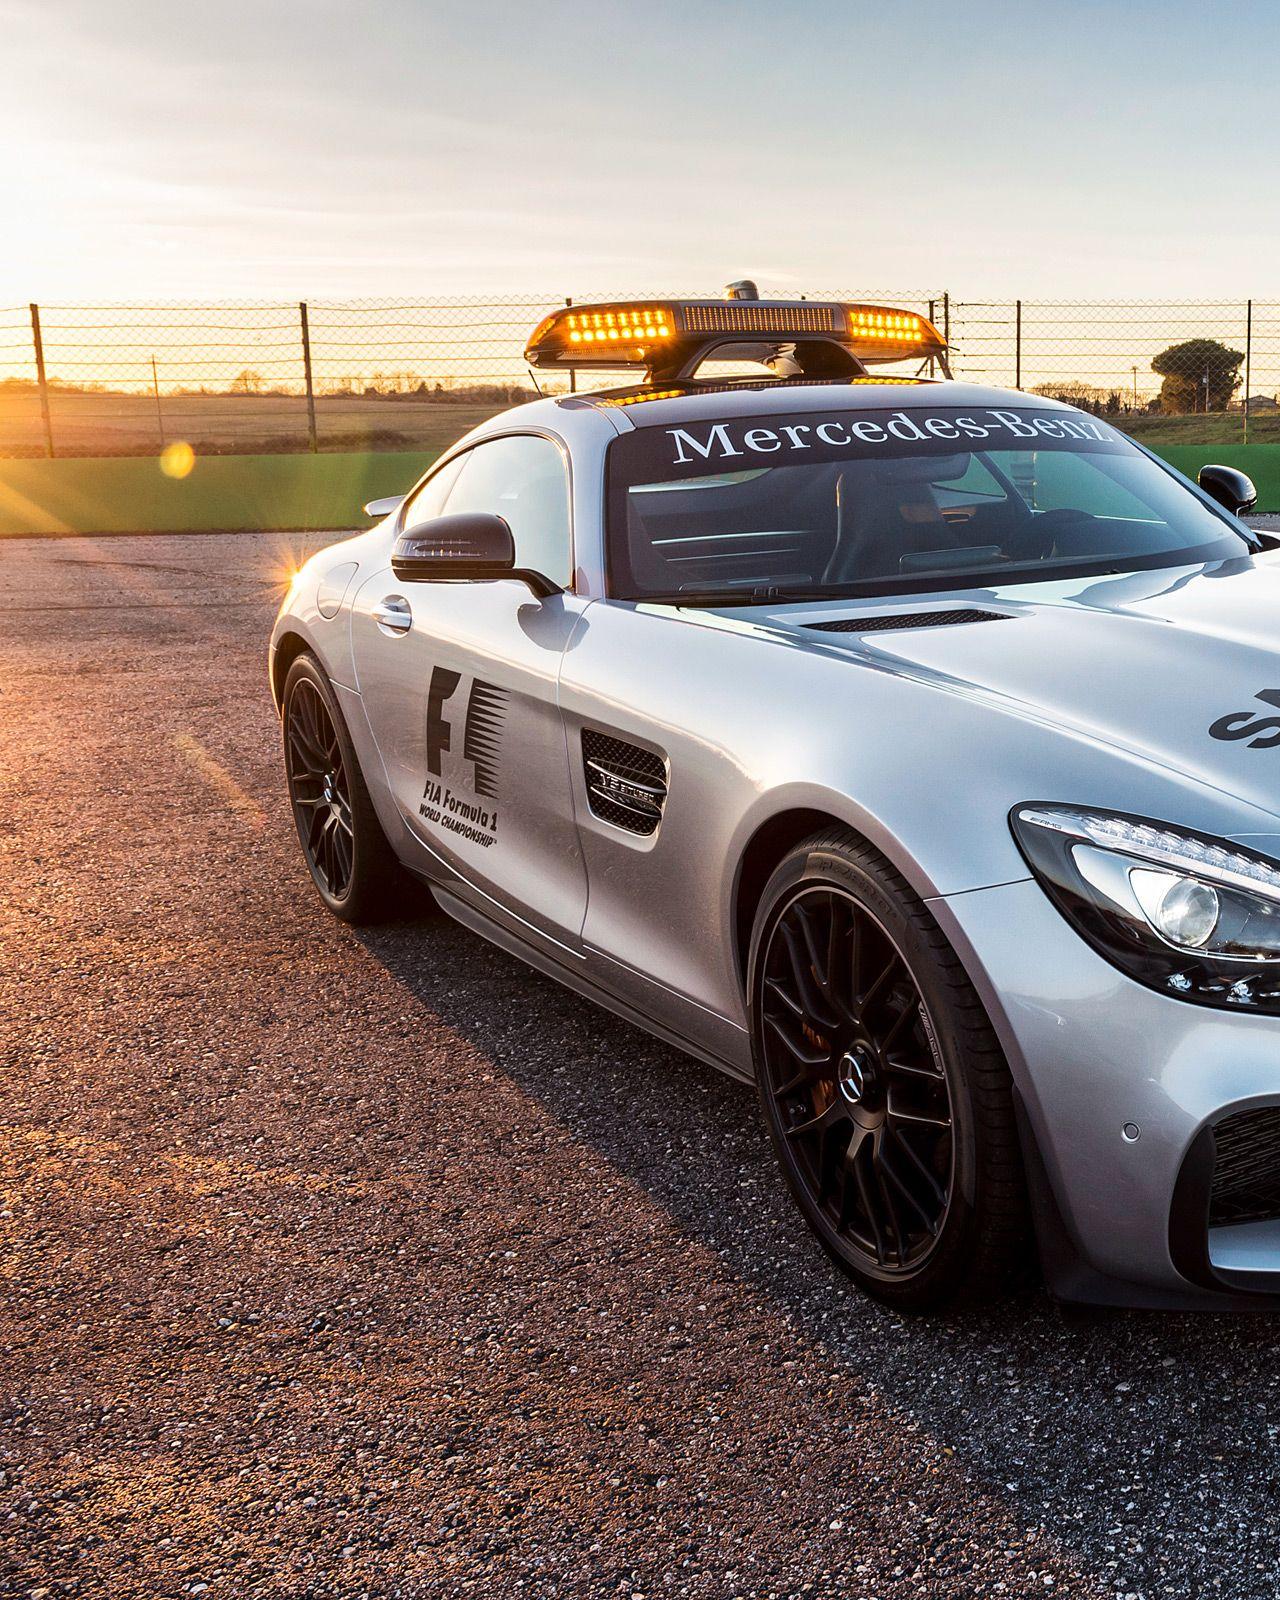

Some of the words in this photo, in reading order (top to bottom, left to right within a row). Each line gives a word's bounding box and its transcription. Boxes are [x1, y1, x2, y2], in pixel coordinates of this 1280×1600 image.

[665, 410, 1116, 465] Mercedes-Benz
[418, 803, 441, 823] WORLD
[423, 779, 442, 806] FIA
[442, 788, 489, 828] Formula
[489, 812, 498, 832] 1
